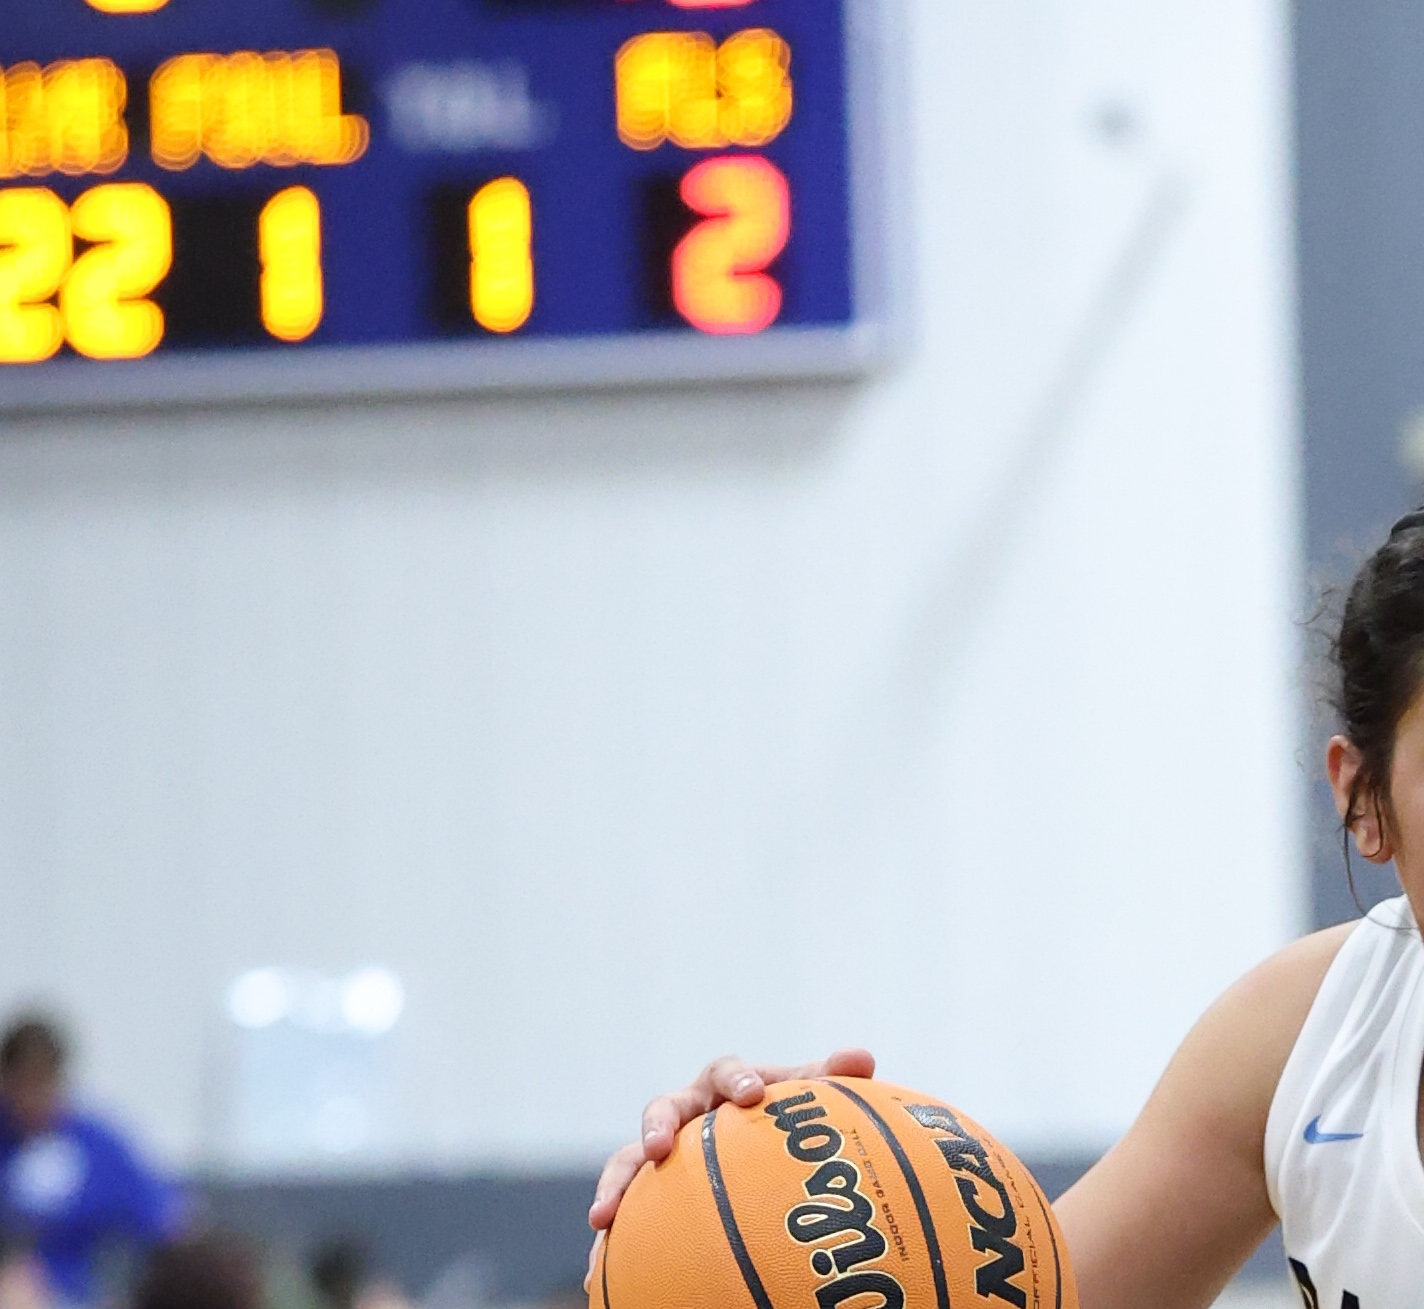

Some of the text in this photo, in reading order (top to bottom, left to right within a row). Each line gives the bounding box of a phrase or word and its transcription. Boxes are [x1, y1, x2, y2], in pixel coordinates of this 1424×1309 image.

[0, 181, 173, 363] 22
[258, 185, 324, 342] 1
[468, 176, 535, 333] 1
[672, 154, 791, 335] 2
